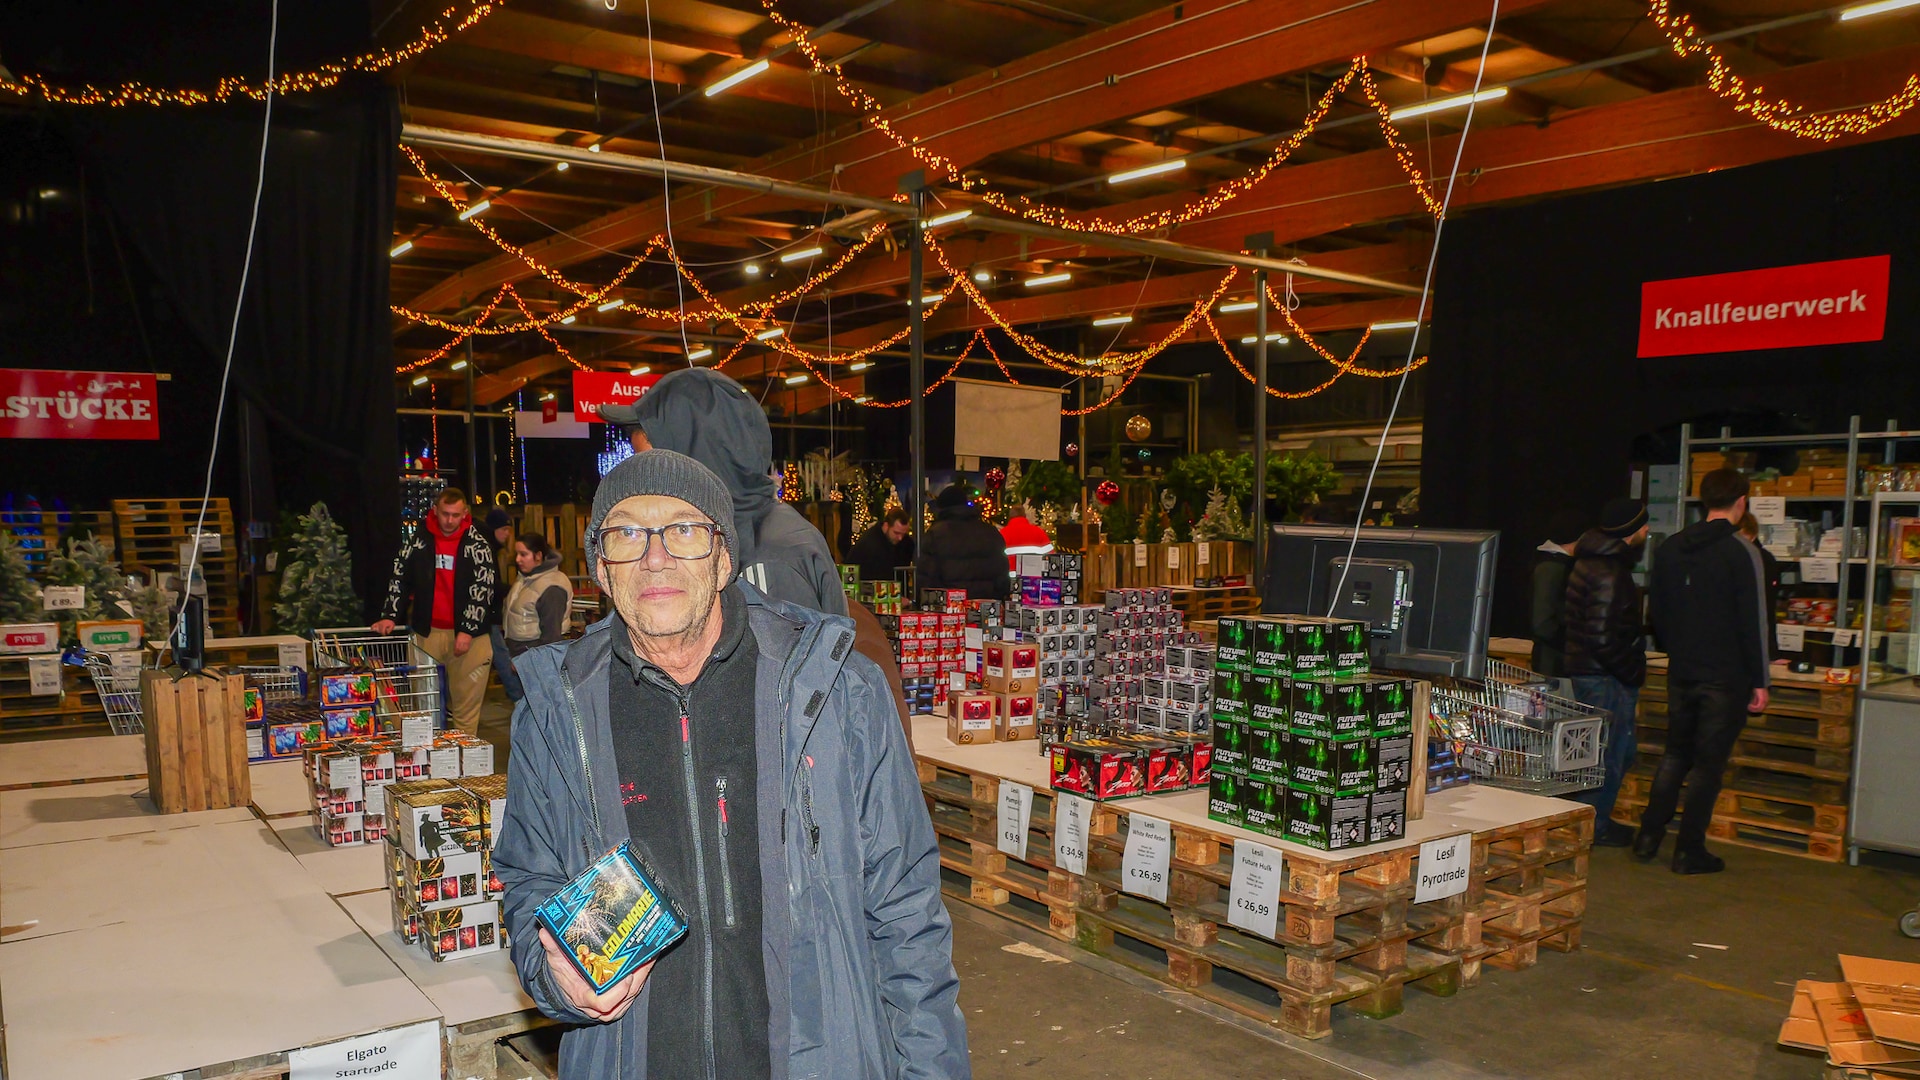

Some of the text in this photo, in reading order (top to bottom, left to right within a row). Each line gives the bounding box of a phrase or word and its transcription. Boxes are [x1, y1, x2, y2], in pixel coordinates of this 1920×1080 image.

[1654, 288, 1867, 330] Knallfeuerwerk
[0, 390, 151, 421] STÜCKE
[13, 635, 38, 644] FYRE
[1219, 646, 1247, 656] FUTURE
[1256, 651, 1286, 661] FUTURE
[1338, 652, 1364, 660] FUTURE
[1219, 652, 1238, 661] HULK
[1256, 657, 1276, 666] HULK
[1297, 654, 1325, 662] FUTURE
[1338, 659, 1356, 667] HULK
[1216, 697, 1244, 708] FUTURE
[1216, 703, 1234, 712] HULK
[1254, 704, 1284, 714] FUTURE
[1253, 711, 1273, 720] HULK
[1294, 710, 1326, 722] FUTURE
[1337, 714, 1366, 723] FUTURE
[1378, 710, 1406, 720] FUTURE
[1294, 717, 1315, 727] HULK
[1337, 722, 1357, 730] HULK
[1377, 718, 1396, 727] HULK
[1215, 748, 1242, 759] FUTURE
[1215, 754, 1233, 764] HULK
[1253, 757, 1283, 768] FUTURE
[1252, 763, 1273, 773] HULK
[1297, 766, 1328, 778] FUTURE
[1296, 773, 1318, 782] HULK
[1341, 770, 1370, 780] FUTURE
[1340, 778, 1361, 786] HULK
[1211, 798, 1238, 811] FUTURE
[1211, 804, 1229, 815] HULK
[1247, 808, 1276, 821] FUTURE
[1247, 814, 1266, 825] HULK
[1291, 819, 1321, 832] FUTURE
[1291, 825, 1311, 836] HULK
[1004, 831, 1009, 840] €
[1132, 829, 1145, 837] White
[1154, 834, 1167, 842] Rebel
[1060, 845, 1084, 860] € 34,99
[1251, 848, 1264, 857] Lesli
[1436, 845, 1456, 861] Lesli
[1242, 856, 1272, 872] Future Hulk
[1130, 868, 1162, 883] € 26,99
[1422, 866, 1466, 888] Pyrotrade
[1237, 897, 1269, 916] € 26,99
[601, 888, 656, 961] GOLDMARIE
[347, 1045, 387, 1061] Elgato
